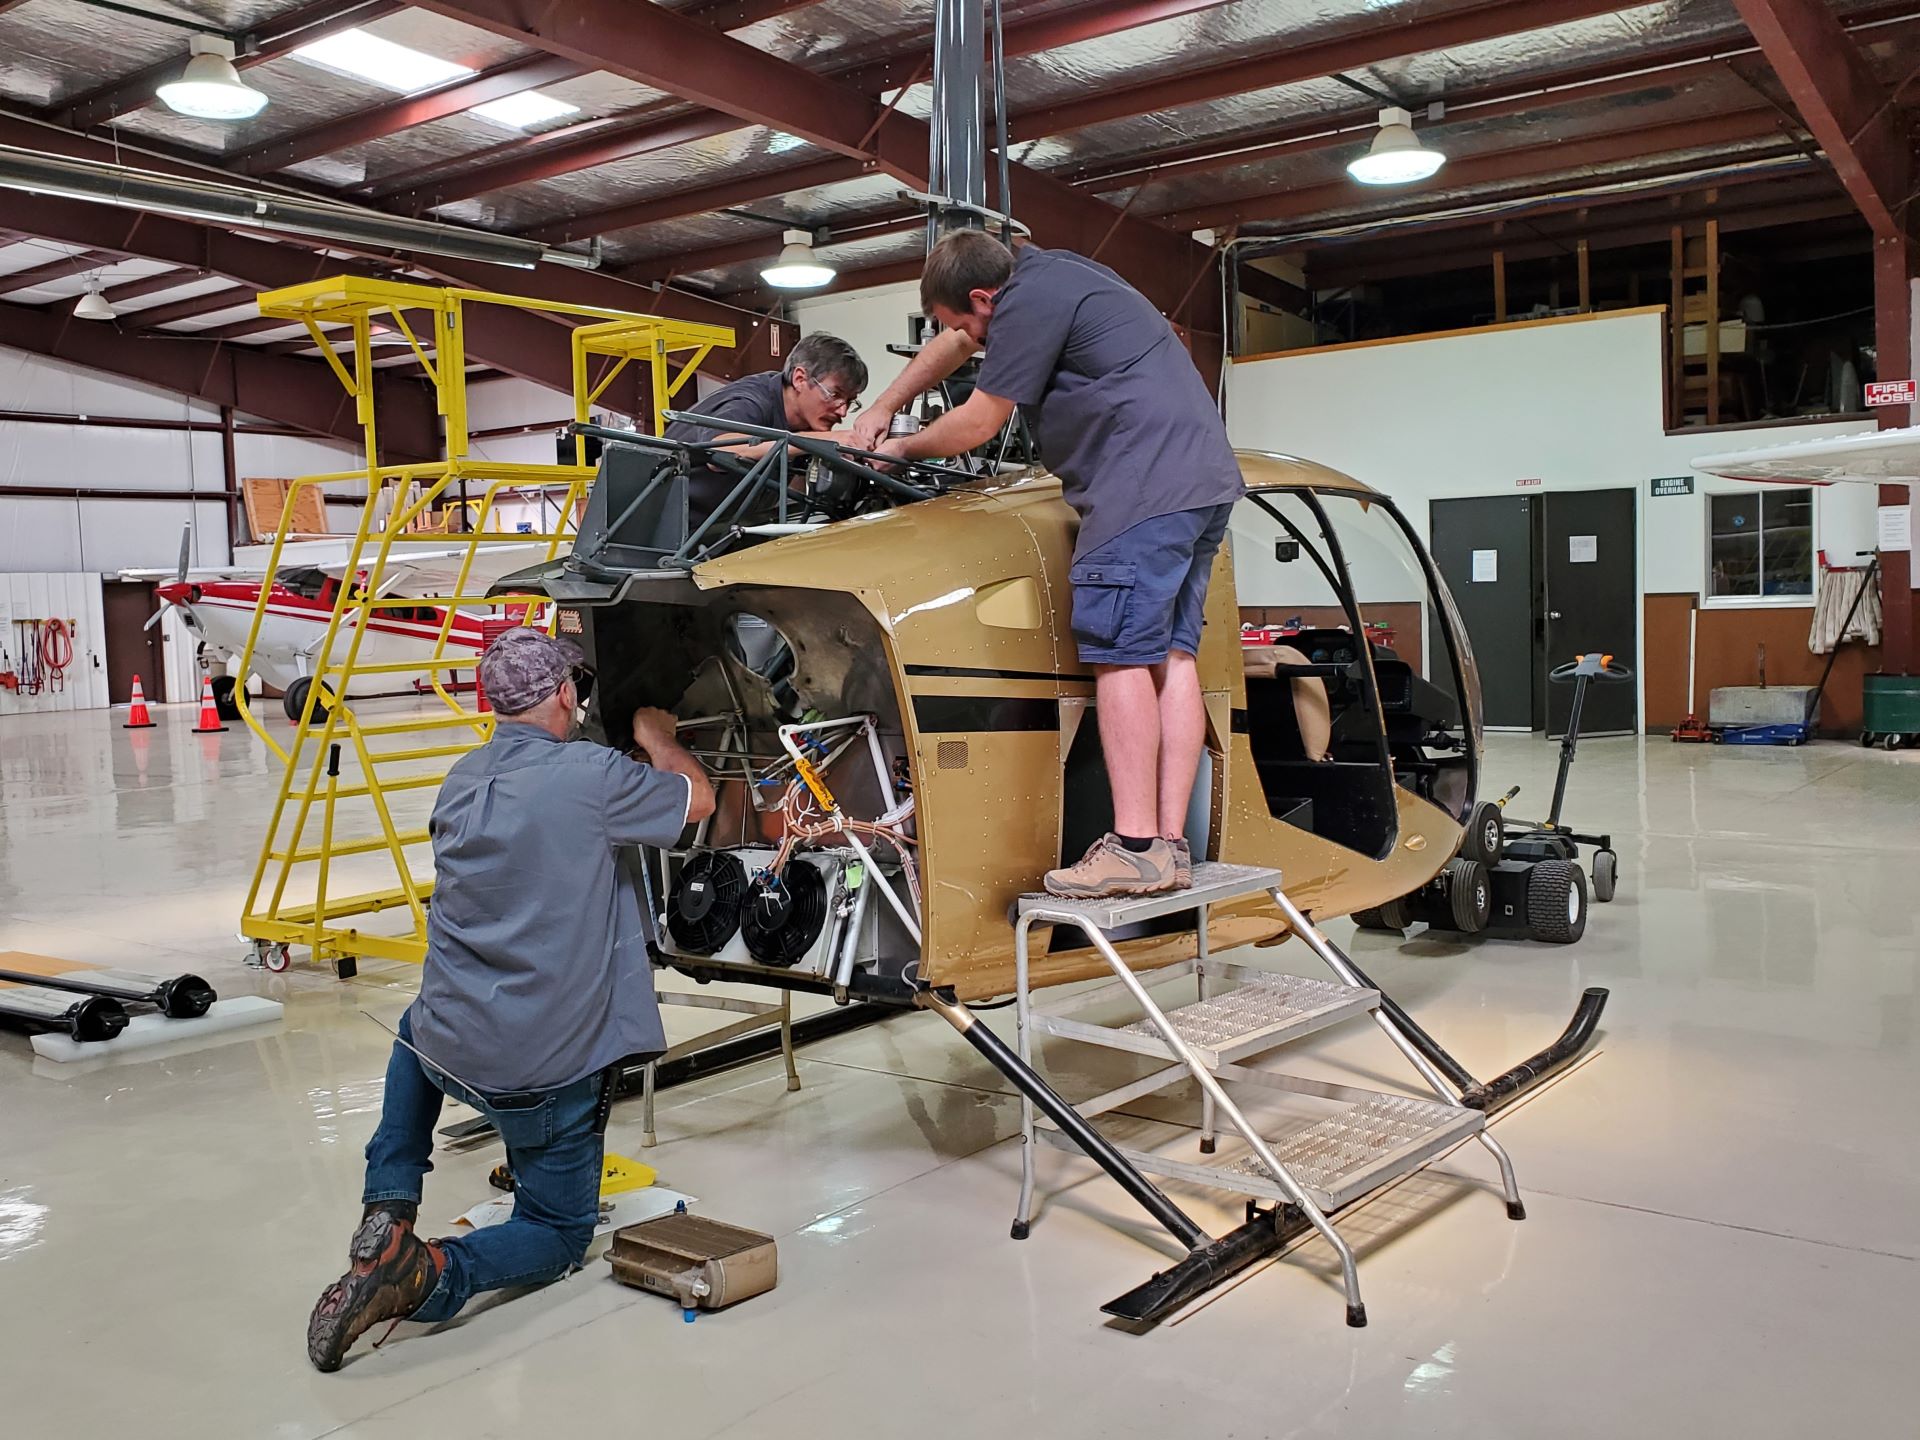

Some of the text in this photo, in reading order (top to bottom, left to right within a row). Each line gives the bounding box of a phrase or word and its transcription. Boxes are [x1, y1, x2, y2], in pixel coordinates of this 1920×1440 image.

[1872, 382, 1908, 394] FIRE
[1868, 392, 1914, 404] HOSE
[1660, 479, 1685, 487] ENGINE
[1655, 486, 1690, 495] OVERHAUL
